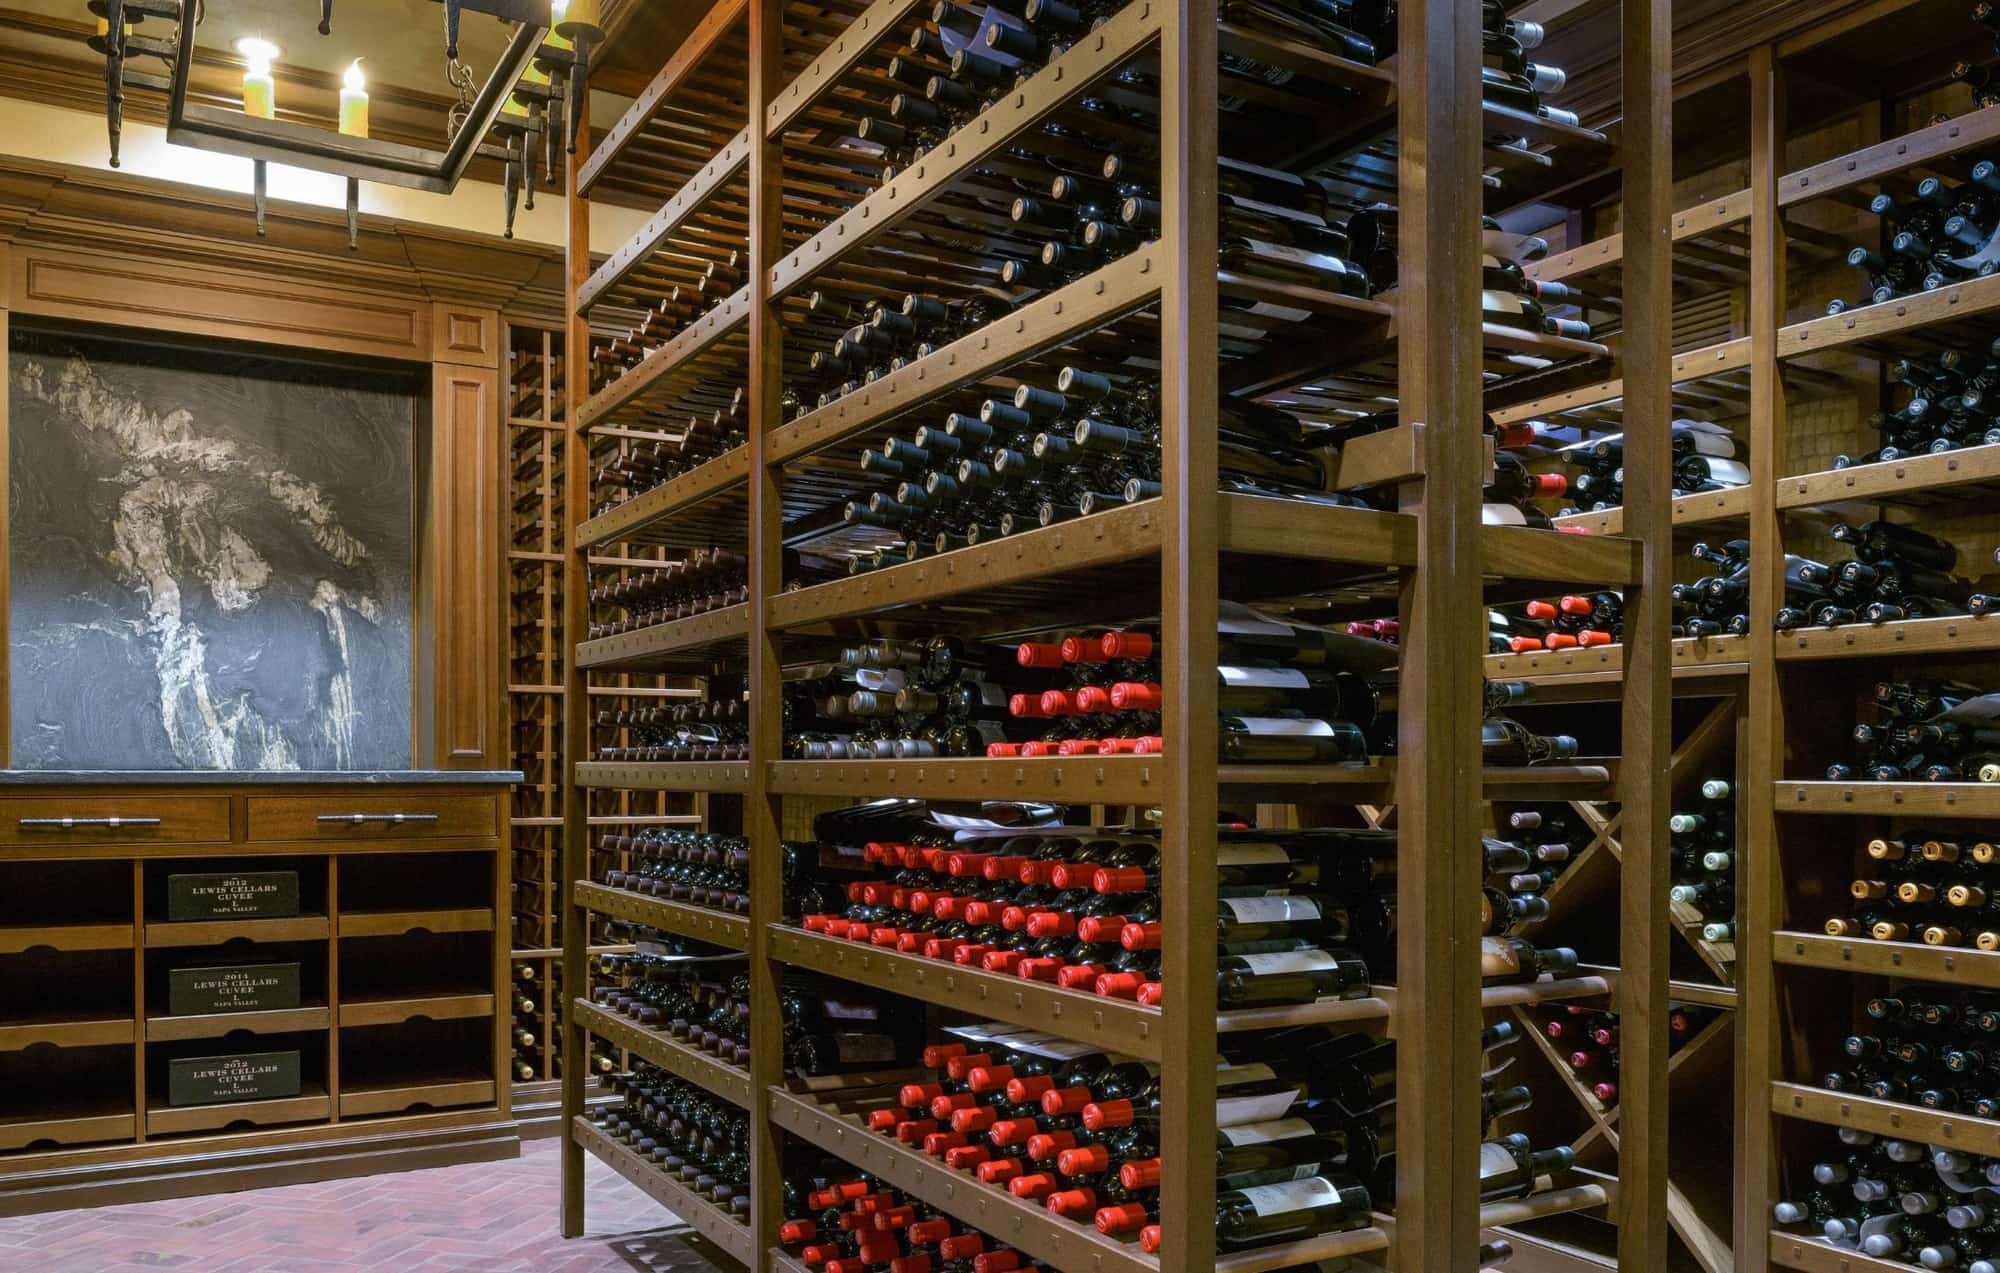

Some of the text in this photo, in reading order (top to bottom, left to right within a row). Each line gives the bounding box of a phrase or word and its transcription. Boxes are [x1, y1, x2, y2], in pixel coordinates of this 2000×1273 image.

[192, 885, 277, 895] LEWIS CELLARS
[193, 979, 279, 989] LEWIS CELLARS
[193, 1065, 278, 1079] LEWIS CELLARS
